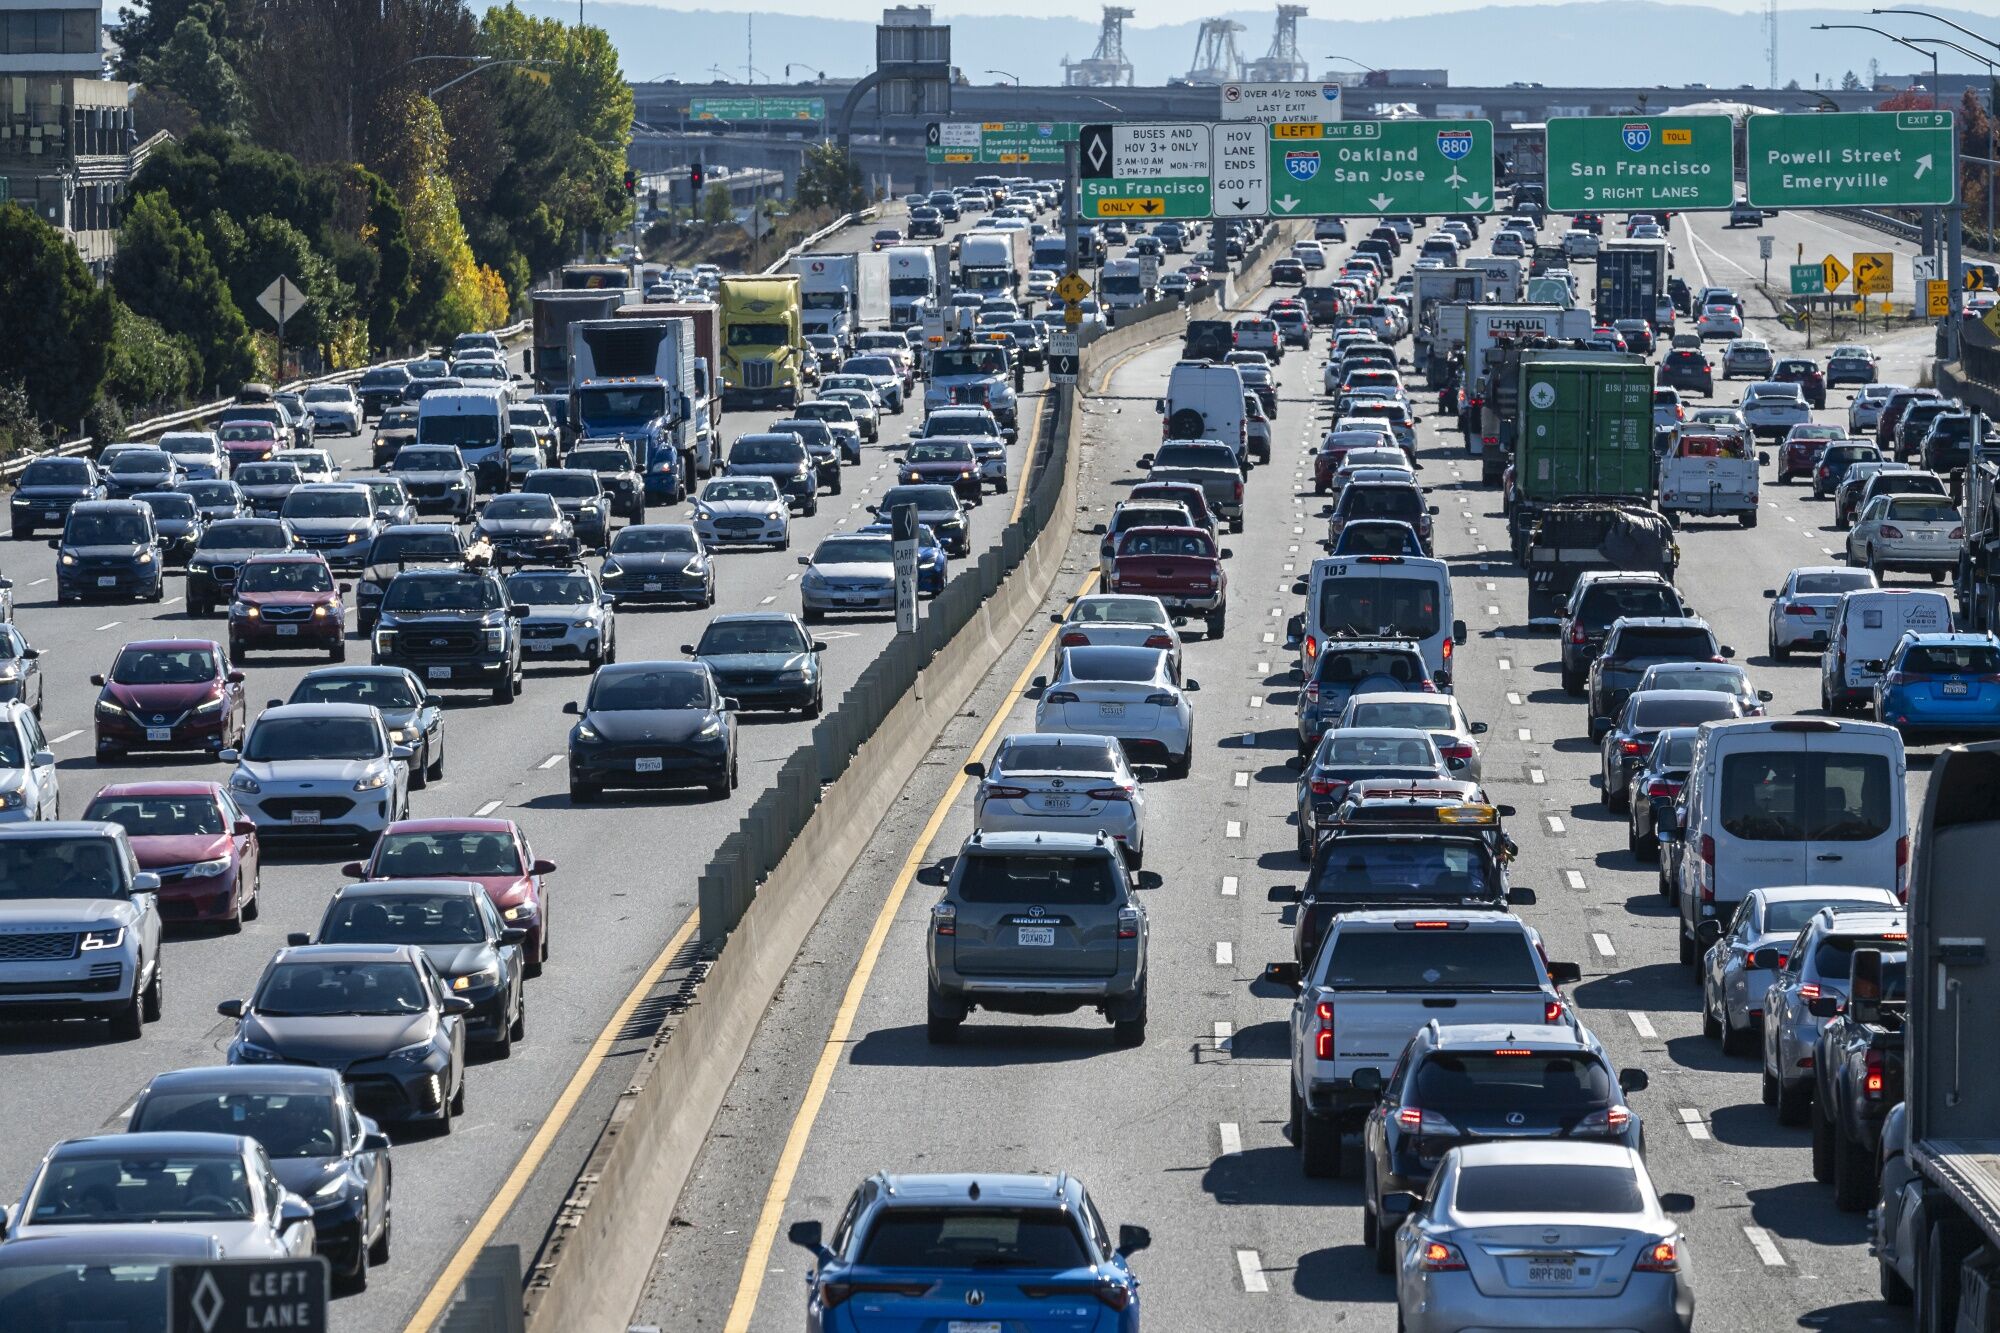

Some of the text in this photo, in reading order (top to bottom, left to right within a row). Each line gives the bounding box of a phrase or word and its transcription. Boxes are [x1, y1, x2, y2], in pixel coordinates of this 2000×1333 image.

[1244, 90, 1267, 98] OVER
[1295, 90, 1317, 98] TONS
[1256, 104, 1305, 112] LAST EXIT
[1907, 114, 1944, 126] EXIT 9
[1133, 129, 1193, 139] BUSES AND
[1281, 125, 1316, 136] LEFT
[1326, 126, 1348, 135] EXIT
[1227, 132, 1252, 141] HOV
[1627, 131, 1647, 145] 80
[1667, 133, 1687, 141] TOLL
[1124, 143, 1145, 153] HOV
[1171, 142, 1199, 152] ONLY
[1224, 146, 1256, 156] LANE
[1442, 139, 1469, 153] 880
[1339, 147, 1418, 162] Oakland
[1768, 148, 1902, 165] Powell Street
[1116, 158, 1122, 166] 5
[1151, 157, 1164, 165] AM
[1224, 160, 1256, 170] ENDS
[1290, 160, 1318, 174] 580
[1119, 168, 1125, 176] 3
[1150, 167, 1161, 175] PM
[1571, 160, 1711, 176] San Francisco
[1334, 167, 1426, 182] San Jose
[1218, 179, 1263, 189] 600 FT
[1782, 173, 1889, 191] Emeryville
[1088, 182, 1205, 195] San Francisco
[1584, 186, 1699, 200] 3 RIGHT LANES
[1102, 202, 1134, 212] ONLY
[1796, 268, 1818, 278] EXIT
[1801, 282, 1808, 291] 9
[1932, 295, 1949, 306] 20
[1490, 318, 1544, 330] U-HAUL
[1323, 564, 1347, 577] 103
[1850, 678, 1859, 686] 51
[249, 1271, 308, 1297] LEFT
[246, 1303, 311, 1329] LANE
